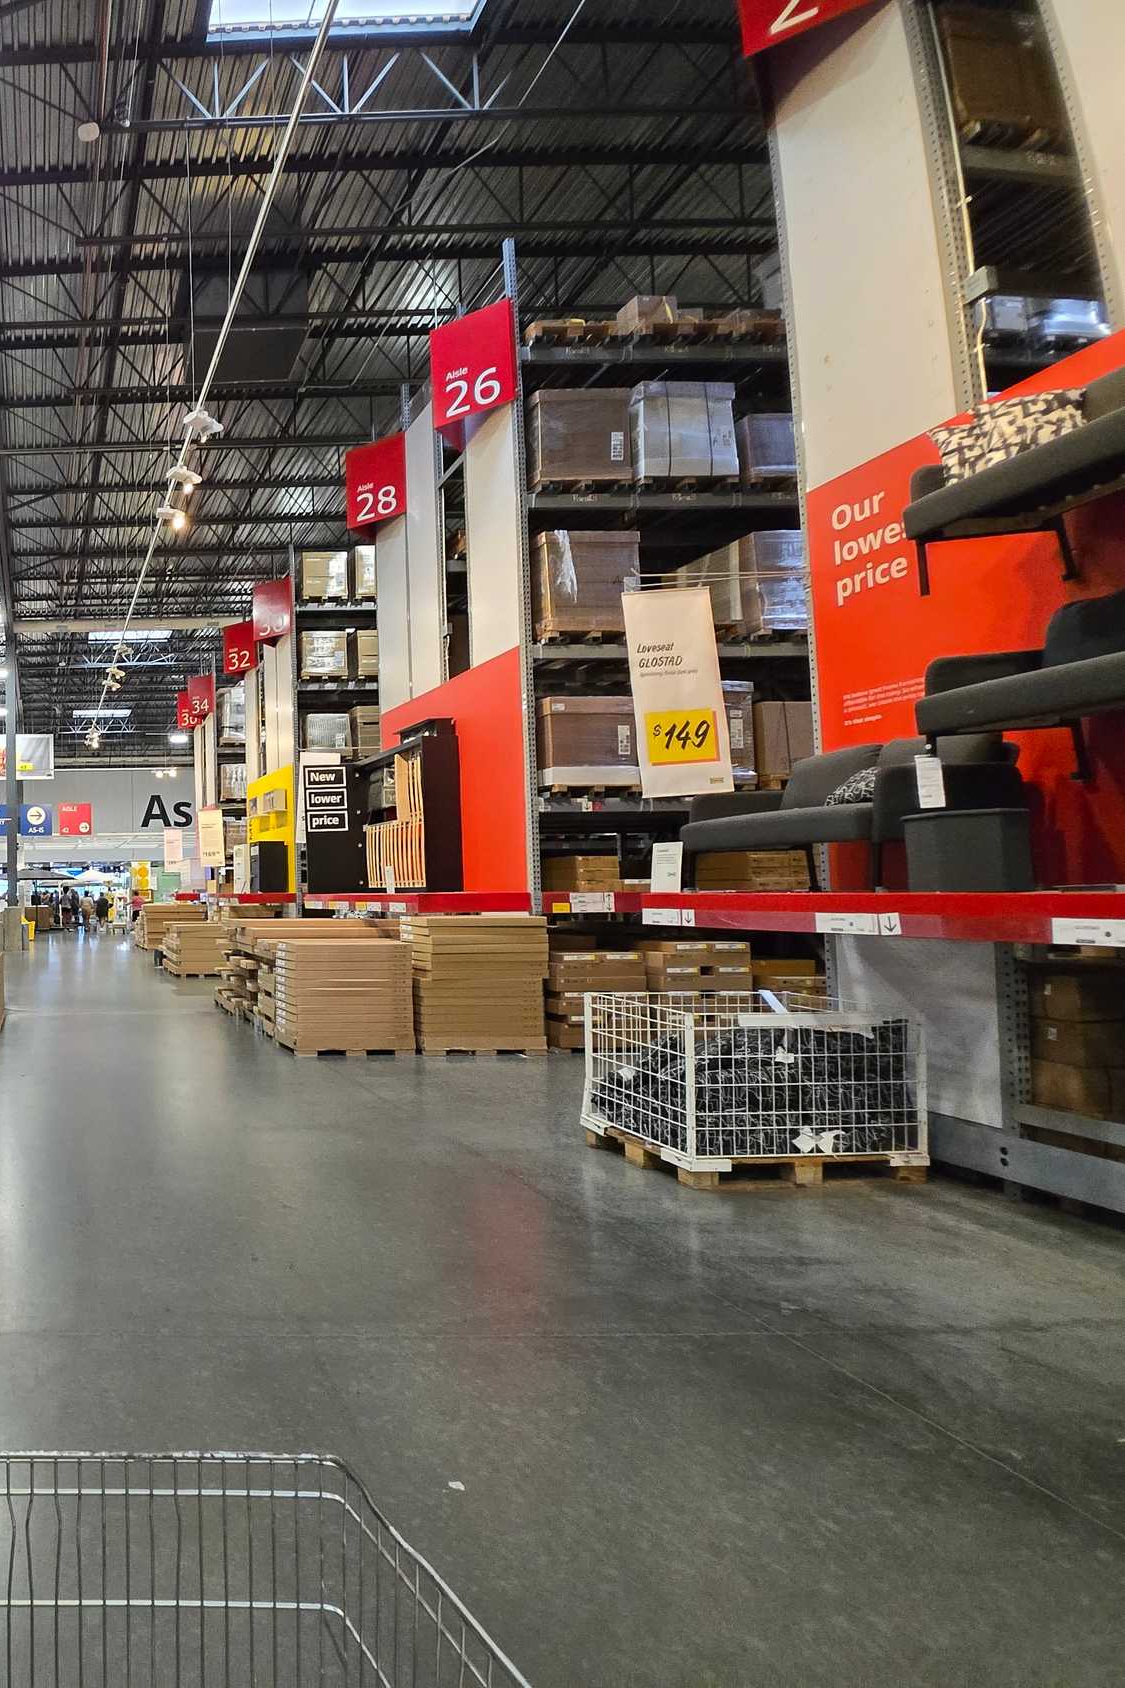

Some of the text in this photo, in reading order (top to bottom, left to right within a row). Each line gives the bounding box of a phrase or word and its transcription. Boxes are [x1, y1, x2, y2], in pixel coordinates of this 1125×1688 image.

[445, 367, 468, 381] Aisle
[445, 367, 501, 418] 26
[356, 482, 374, 493] Aisle
[356, 485, 397, 522] 28
[831, 491, 885, 530] Our
[834, 522, 907, 566] lowe
[836, 556, 908, 607] price
[637, 642, 674, 654] Loveseat
[228, 650, 251, 671] 32
[638, 655, 683, 669] GLOSTAD
[191, 698, 210, 714] 34
[652, 720, 711, 750] $149
[310, 772, 336, 782] New
[310, 793, 342, 804] lower
[140, 794, 193, 828] As
[311, 814, 340, 829] price
